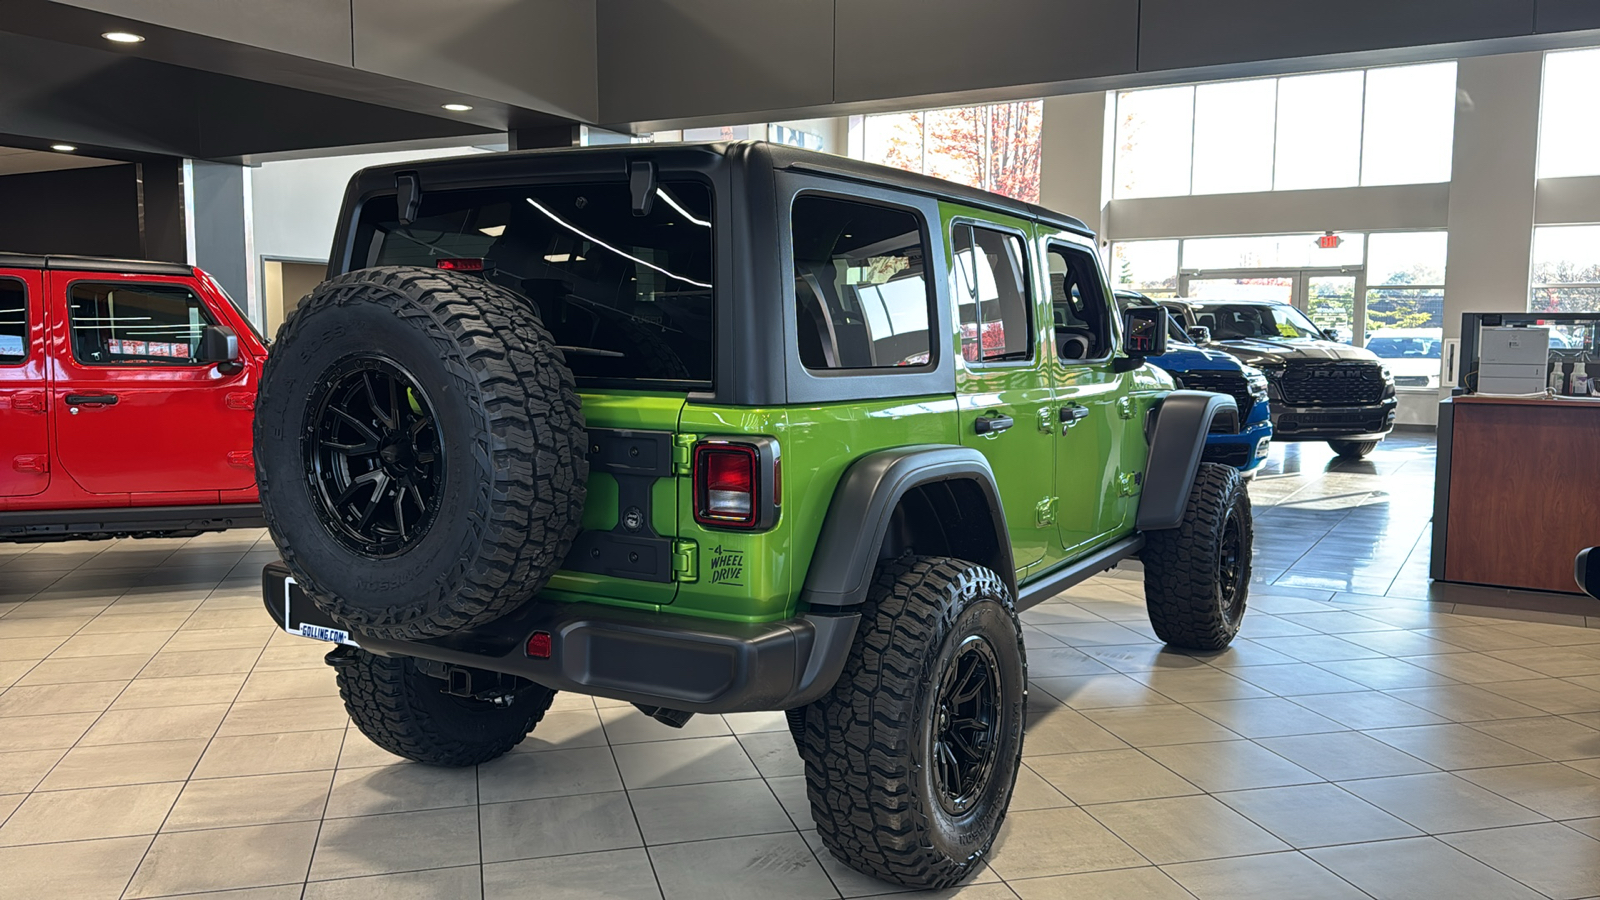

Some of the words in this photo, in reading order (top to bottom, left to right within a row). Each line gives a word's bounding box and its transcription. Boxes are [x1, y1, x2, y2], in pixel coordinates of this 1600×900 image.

[714, 545, 722, 555] 4
[711, 555, 743, 570] WHEEL
[711, 567, 742, 584] DRIVE
[302, 625, 345, 642] GOLLING.COM
